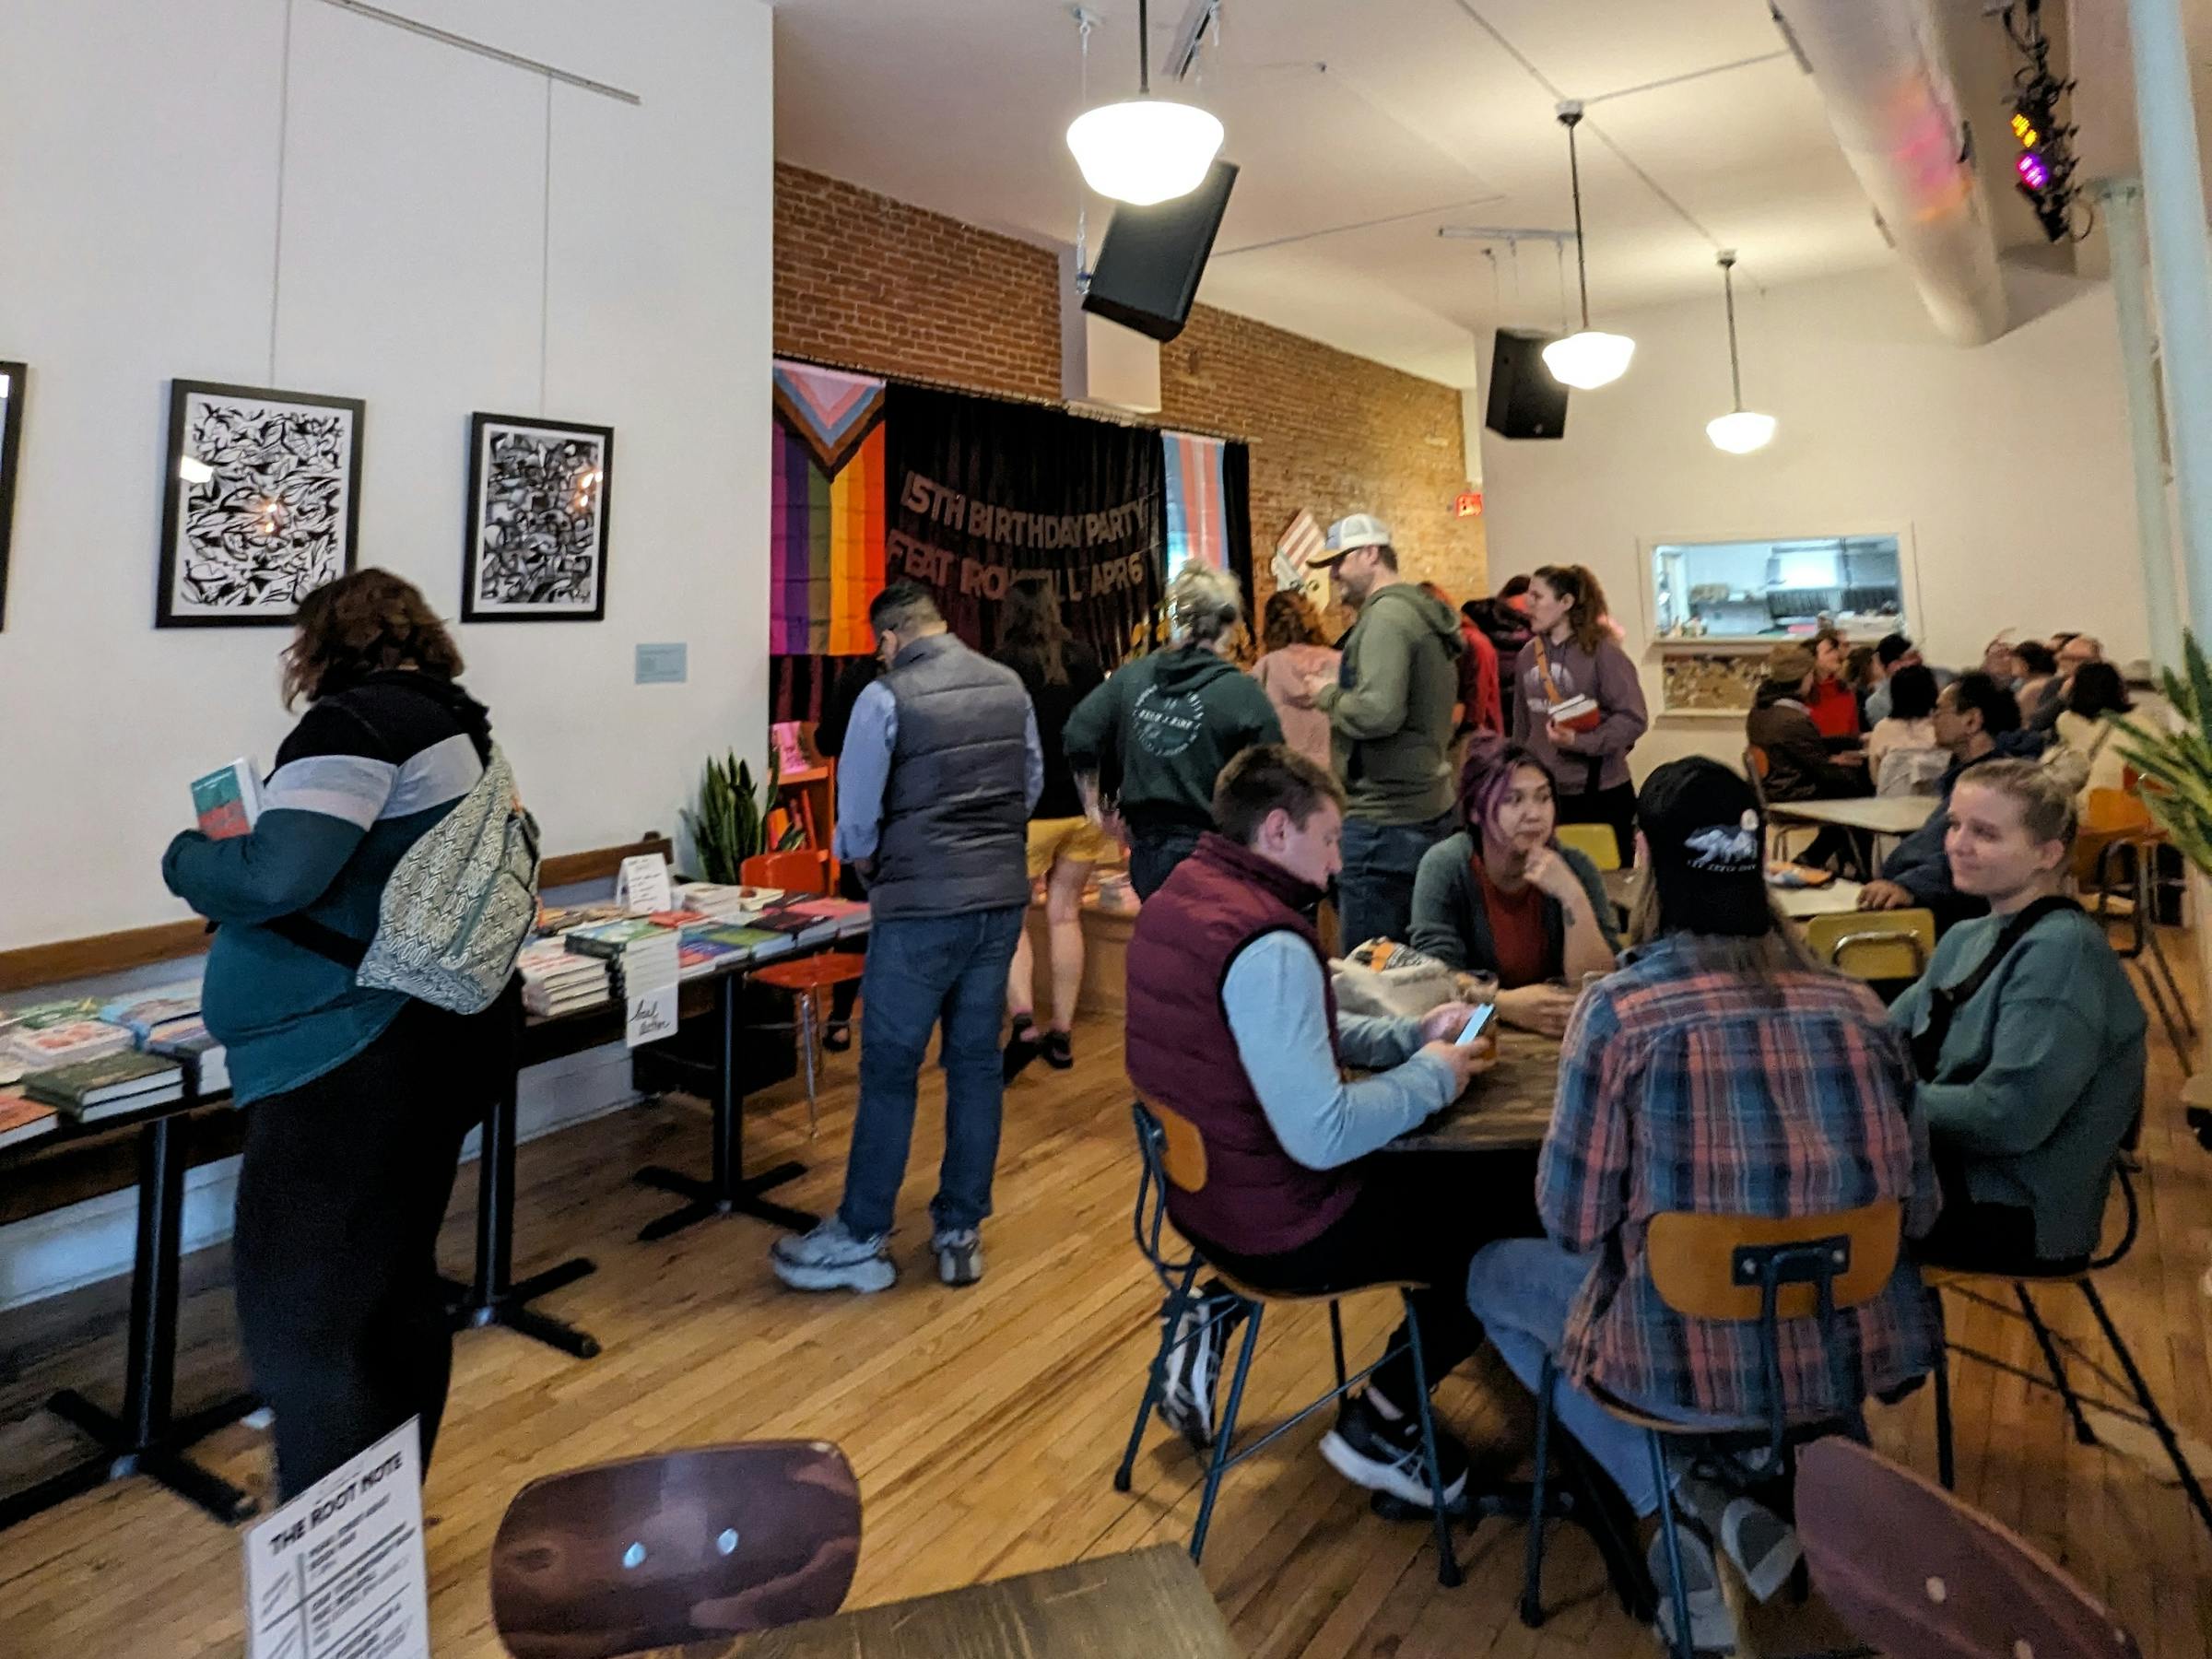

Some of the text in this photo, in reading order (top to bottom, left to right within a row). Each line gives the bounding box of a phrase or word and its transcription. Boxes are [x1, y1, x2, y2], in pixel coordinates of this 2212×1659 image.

[900, 471, 1147, 548] 15TH BIRTHDAY PARTY
[887, 530, 955, 587] FEAT
[270, 1518, 306, 1555] THE
[311, 1482, 357, 1529] ROOT
[360, 1452, 403, 1491] NOTE
